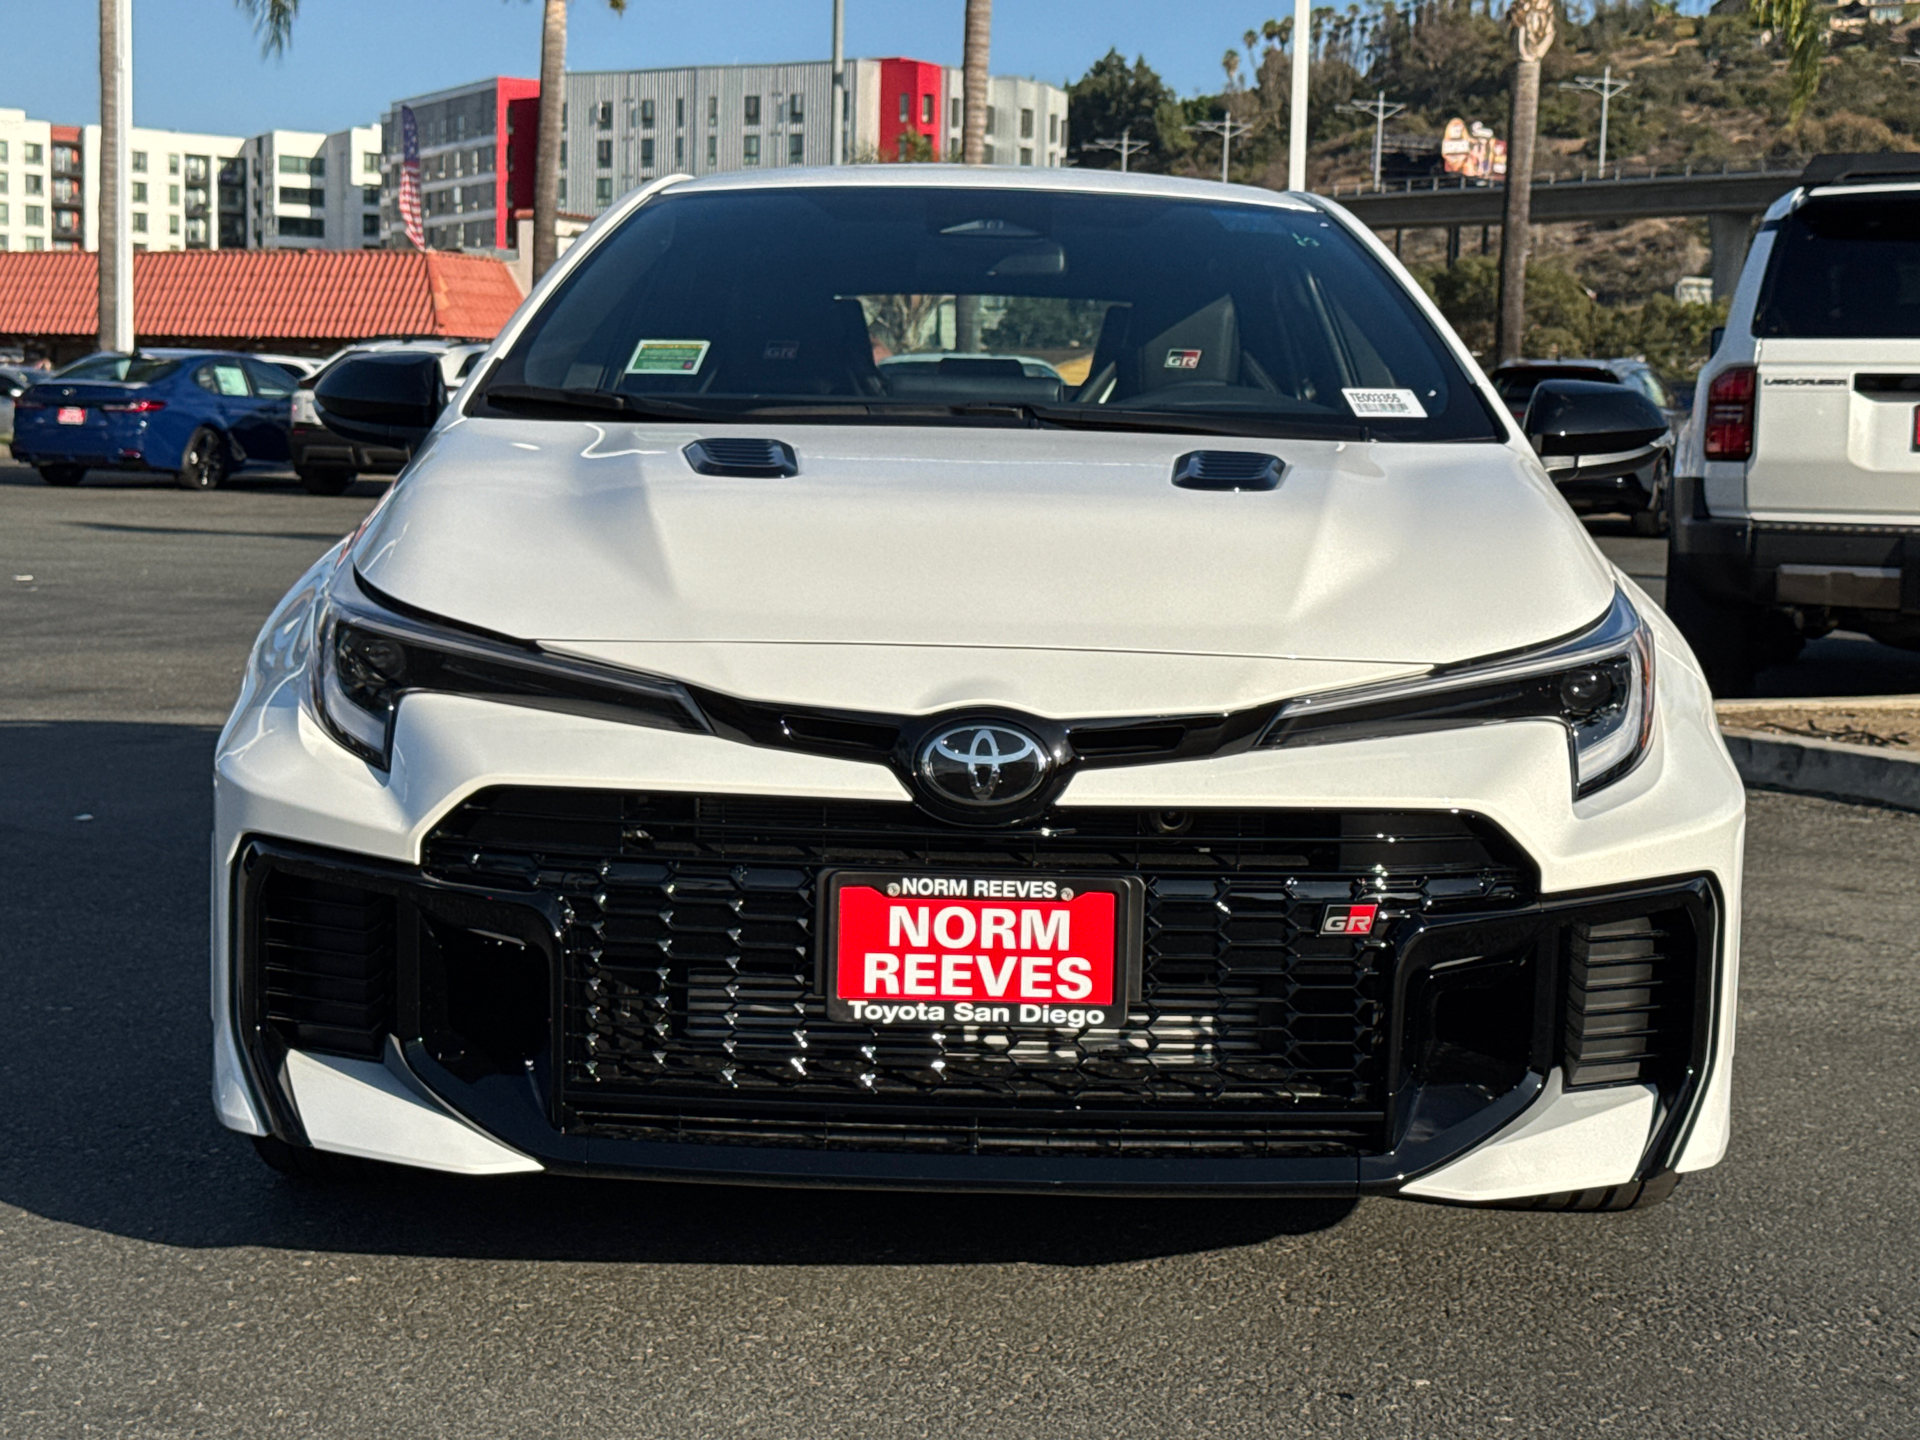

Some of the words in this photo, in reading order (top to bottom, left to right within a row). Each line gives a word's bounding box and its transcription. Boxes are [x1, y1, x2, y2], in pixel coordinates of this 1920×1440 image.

[1168, 356, 1197, 366] GR
[902, 877, 967, 897] NORM
[973, 879, 1057, 899] REEVES
[888, 905, 1070, 951] NORM
[1325, 916, 1371, 931] GR
[864, 953, 1093, 1000] REEVES
[848, 1000, 945, 1025] Toyota
[953, 1002, 1010, 1023] San
[1019, 1004, 1105, 1028] Diego
